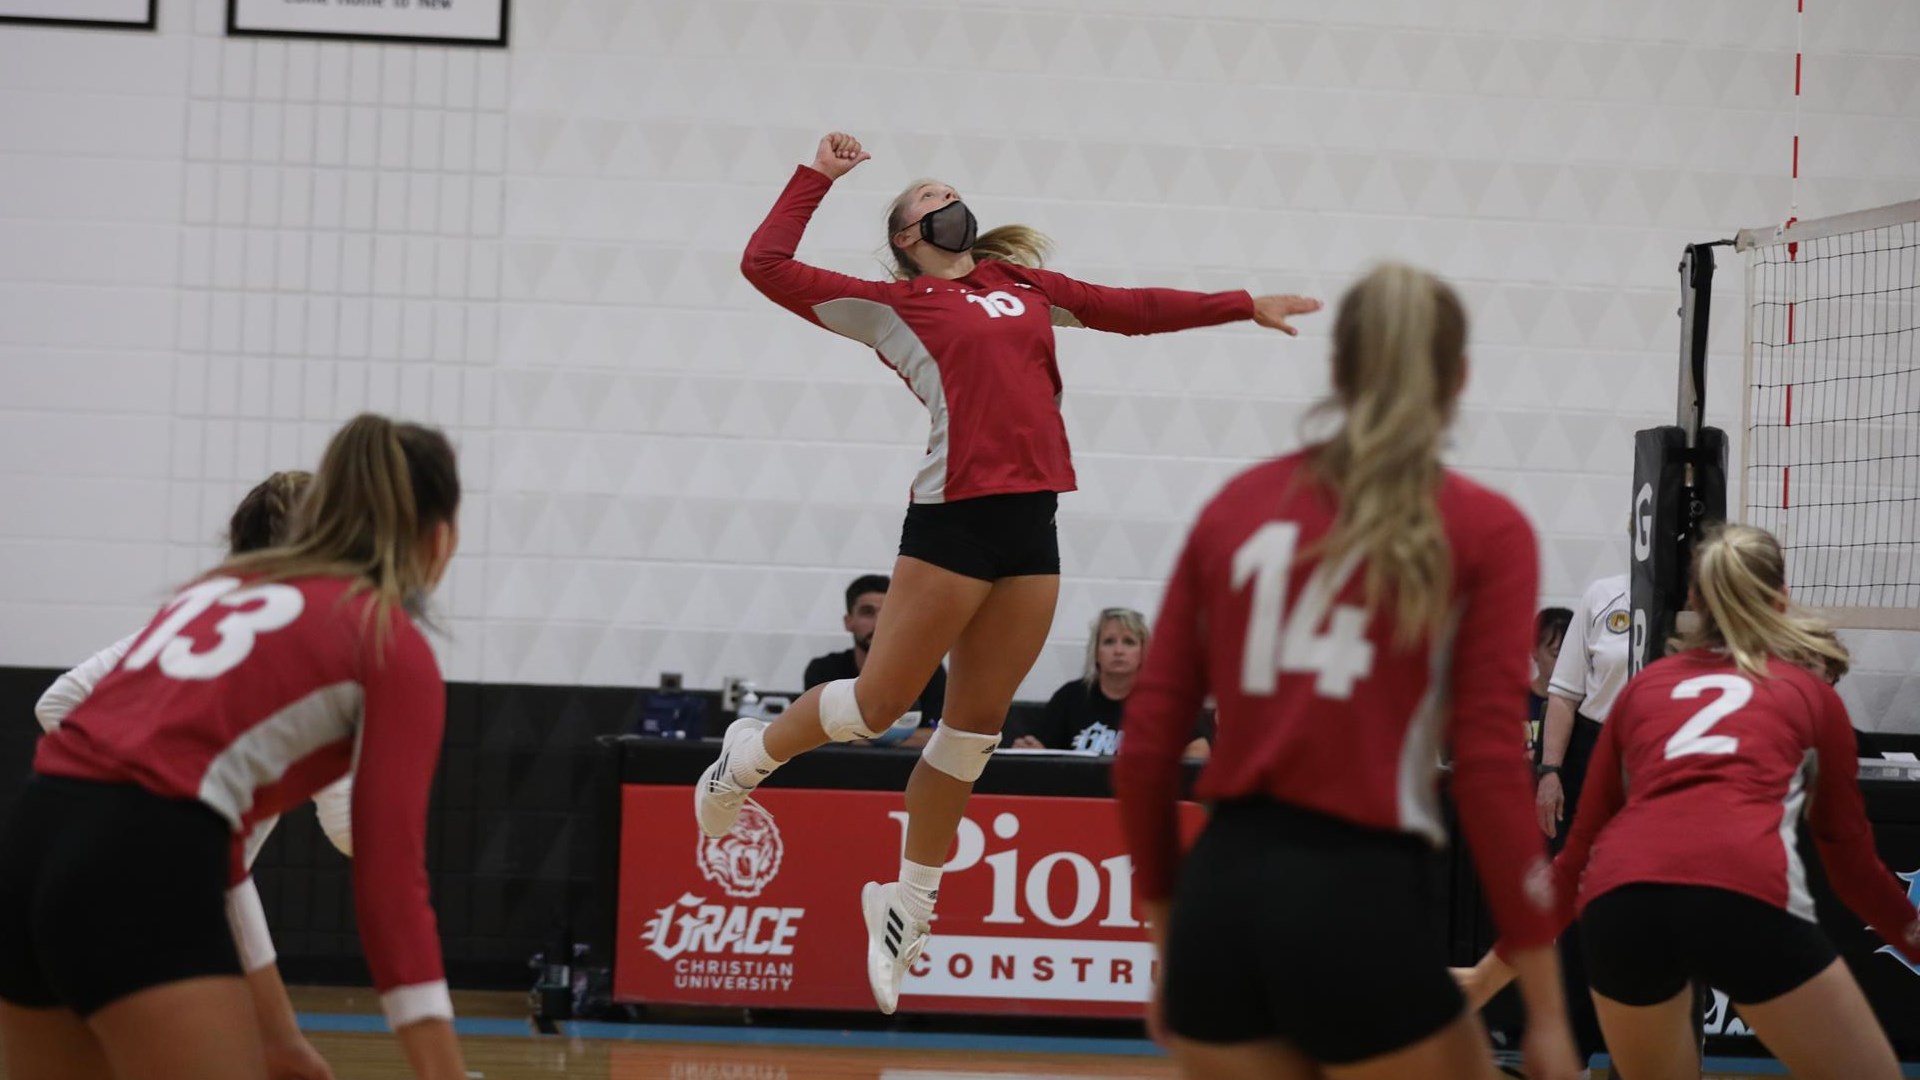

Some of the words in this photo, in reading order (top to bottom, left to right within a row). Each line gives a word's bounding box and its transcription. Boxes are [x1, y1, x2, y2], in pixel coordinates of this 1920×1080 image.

[966, 291, 1025, 318] 10
[122, 576, 305, 680] 13
[1230, 521, 1375, 699] 14
[1664, 674, 1754, 760] 2
[640, 892, 805, 961] GRACE
[675, 959, 793, 976] CHRISTIAN
[675, 975, 792, 991] UNIVERSITY
[908, 952, 1158, 984] CONSTR
